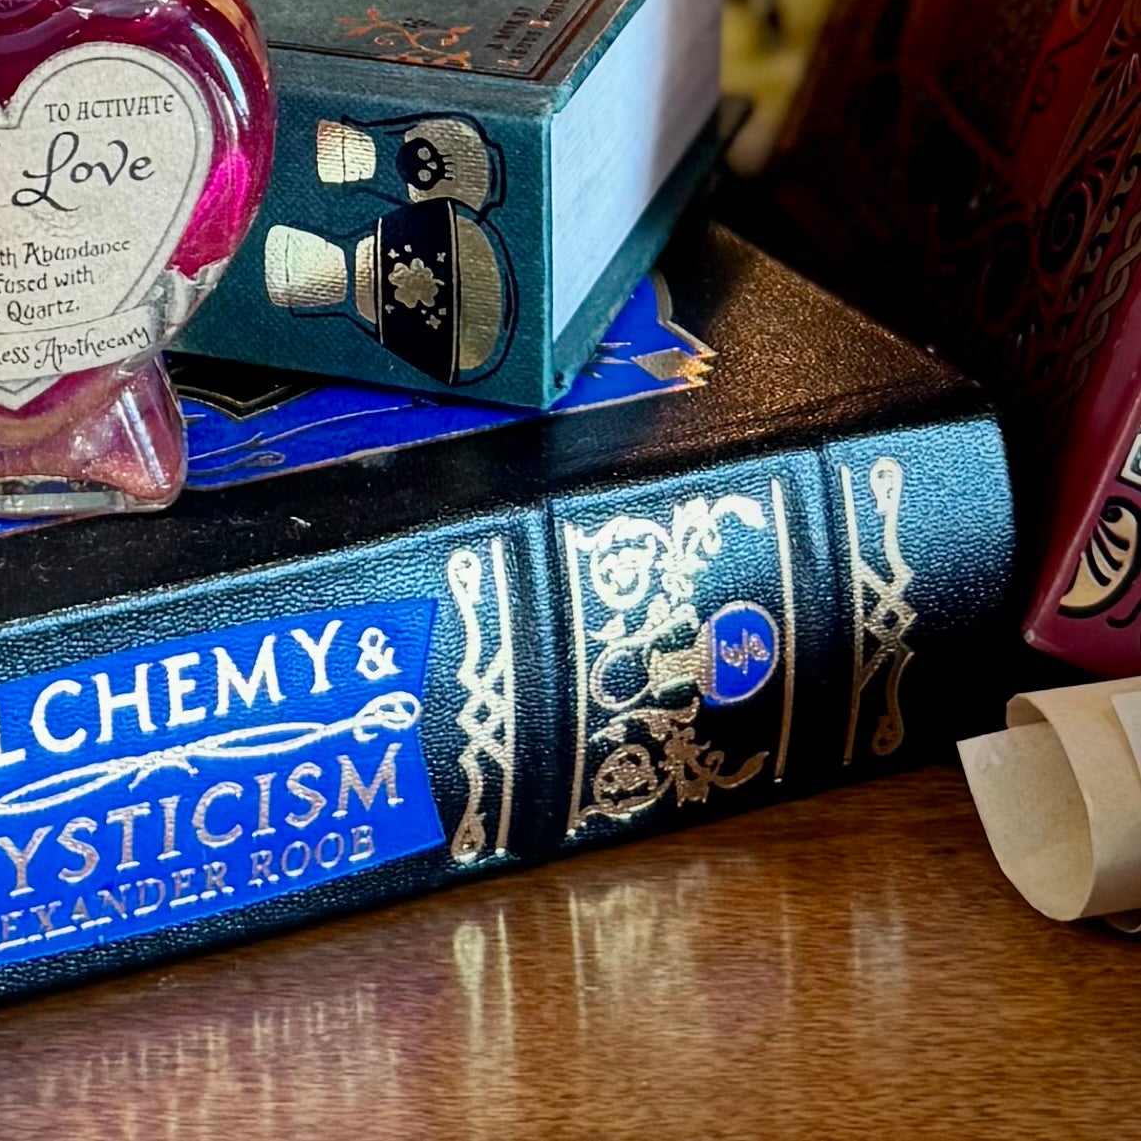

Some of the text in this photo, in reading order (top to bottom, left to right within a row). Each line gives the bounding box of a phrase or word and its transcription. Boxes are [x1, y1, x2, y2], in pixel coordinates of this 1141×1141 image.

[45, 103, 71, 123] TO
[76, 94, 175, 120] ACTIVATE
[11, 131, 156, 212] Love
[23, 240, 131, 267] Abundance
[54, 266, 96, 291] with
[7, 300, 81, 325] Quartz.
[34, 322, 152, 371] Apothecary
[356, 627, 401, 680] &
[248, 825, 375, 887] ROOB
